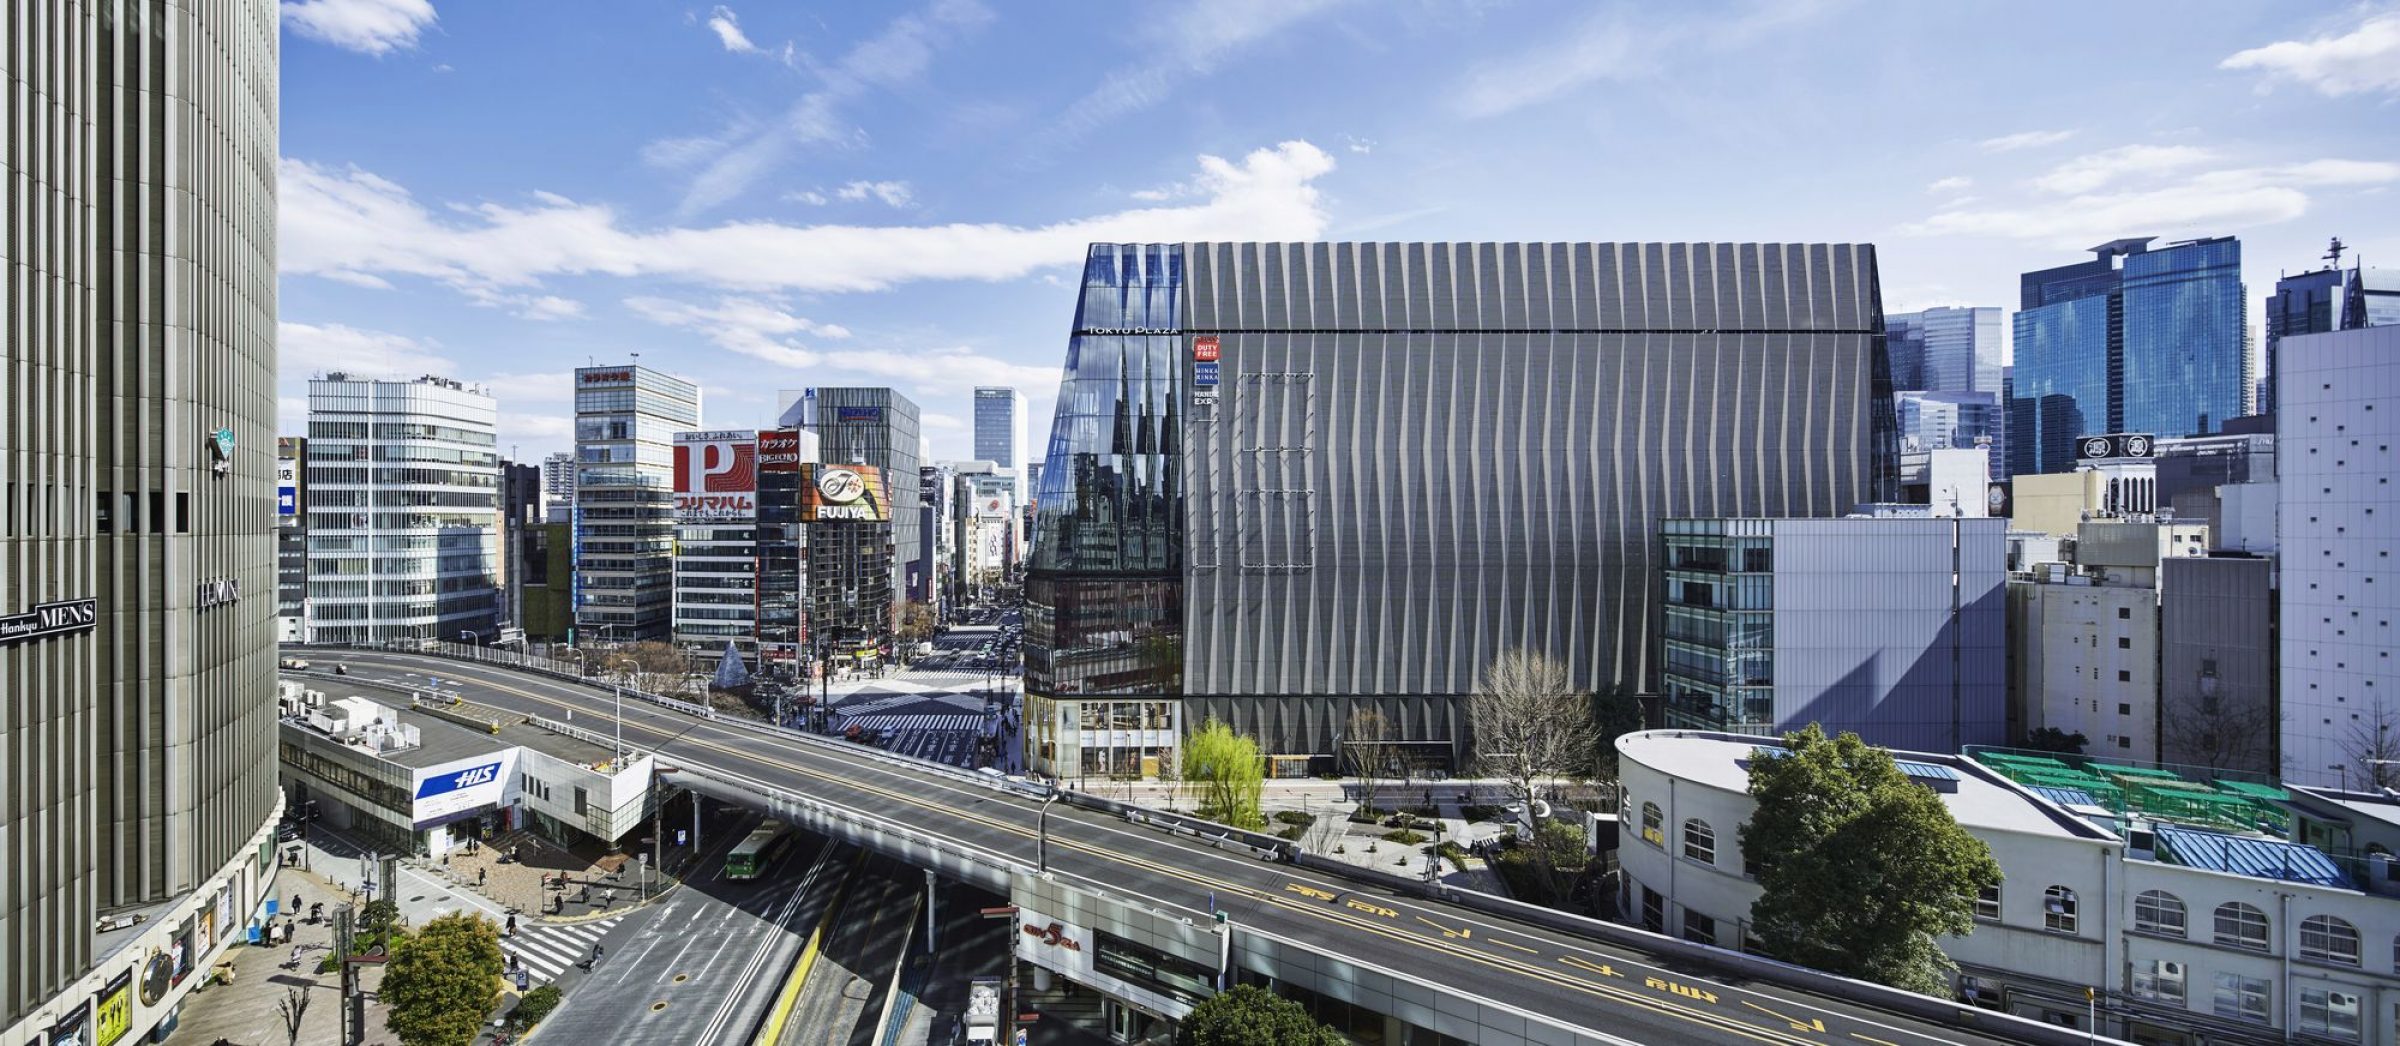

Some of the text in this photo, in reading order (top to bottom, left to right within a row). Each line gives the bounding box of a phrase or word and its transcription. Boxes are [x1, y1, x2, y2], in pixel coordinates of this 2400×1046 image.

[1089, 326, 1178, 334] TOKYU PLAZA
[760, 438, 798, 449] カラオケ
[817, 505, 866, 519] FUJIYA
[1, 620, 38, 635] Hankyu
[455, 765, 495, 788] HIS
